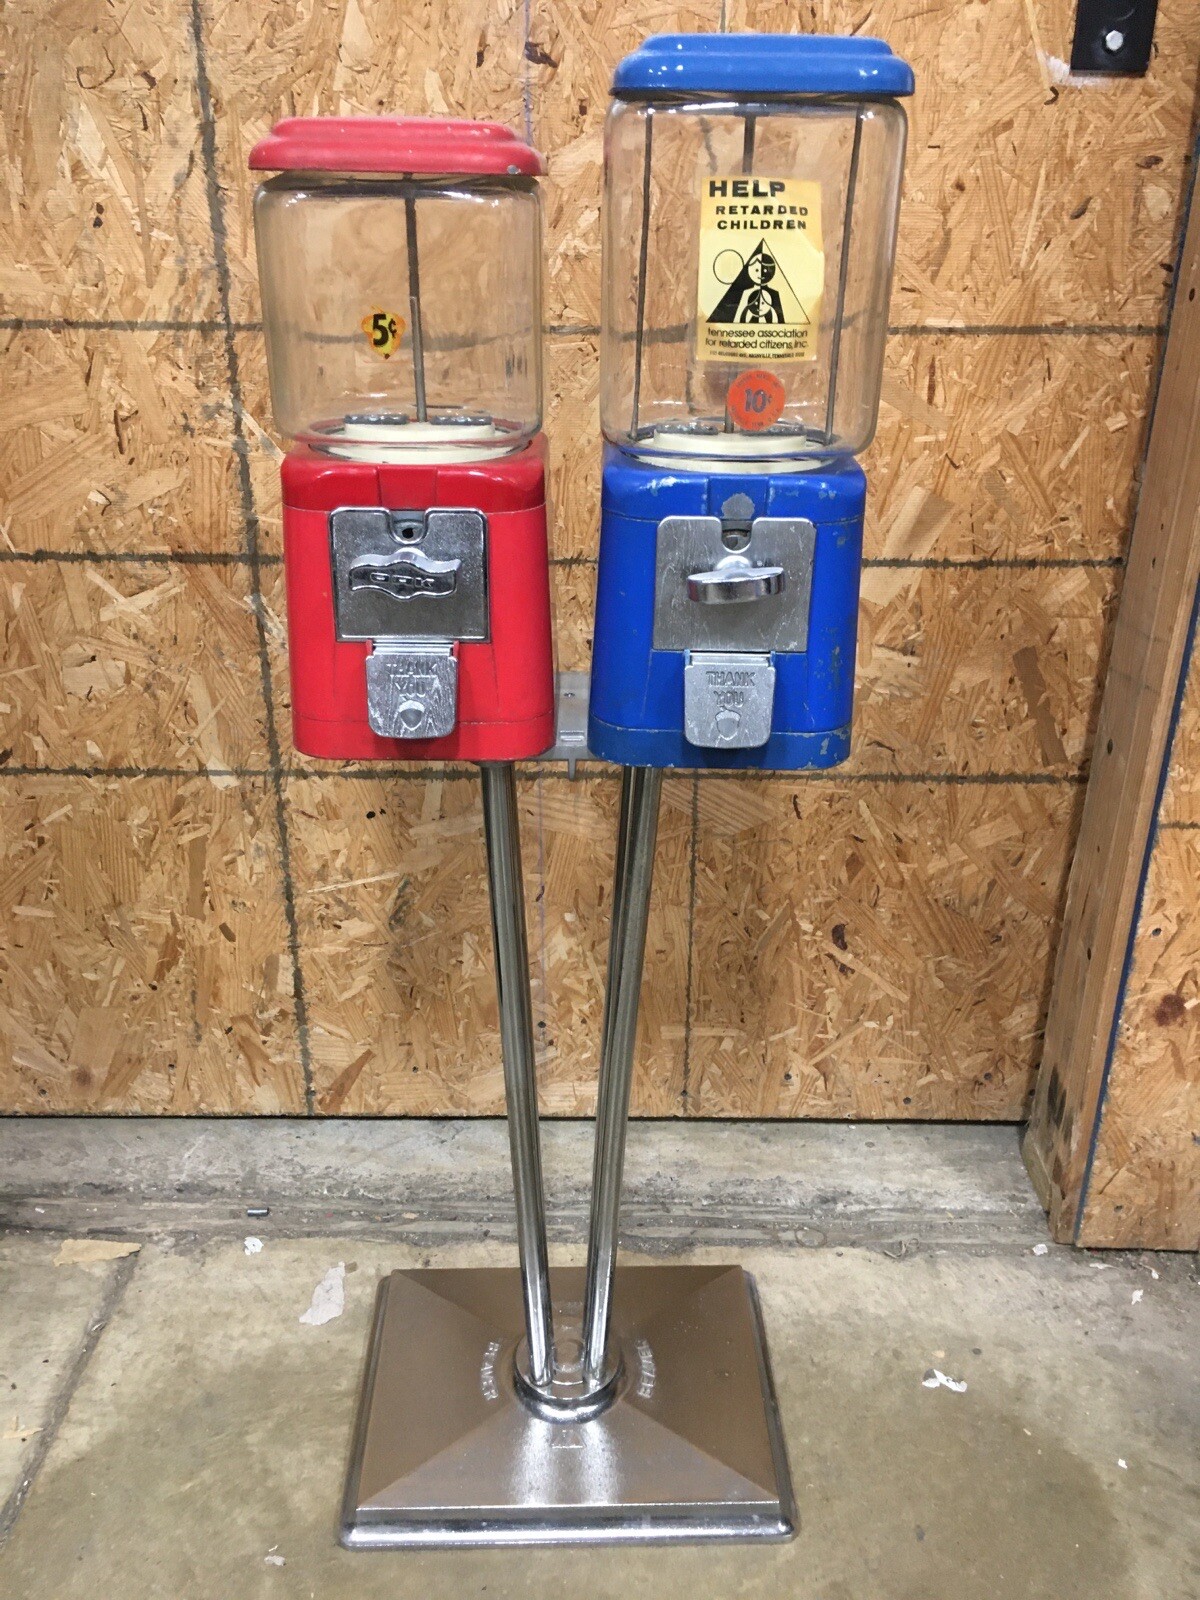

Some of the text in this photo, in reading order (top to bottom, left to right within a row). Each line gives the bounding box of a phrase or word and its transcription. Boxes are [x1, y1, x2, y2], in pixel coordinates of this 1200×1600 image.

[709, 180, 786, 198] HELP
[715, 205, 808, 216] RETARDED
[717, 220, 807, 230] CHILDREN
[373, 313, 397, 347] 5¢
[708, 327, 808, 338] tennessee association
[705, 338, 717, 347] for
[719, 339, 758, 349] retarded
[705, 671, 756, 688] THANK
[713, 690, 745, 707] YOU
